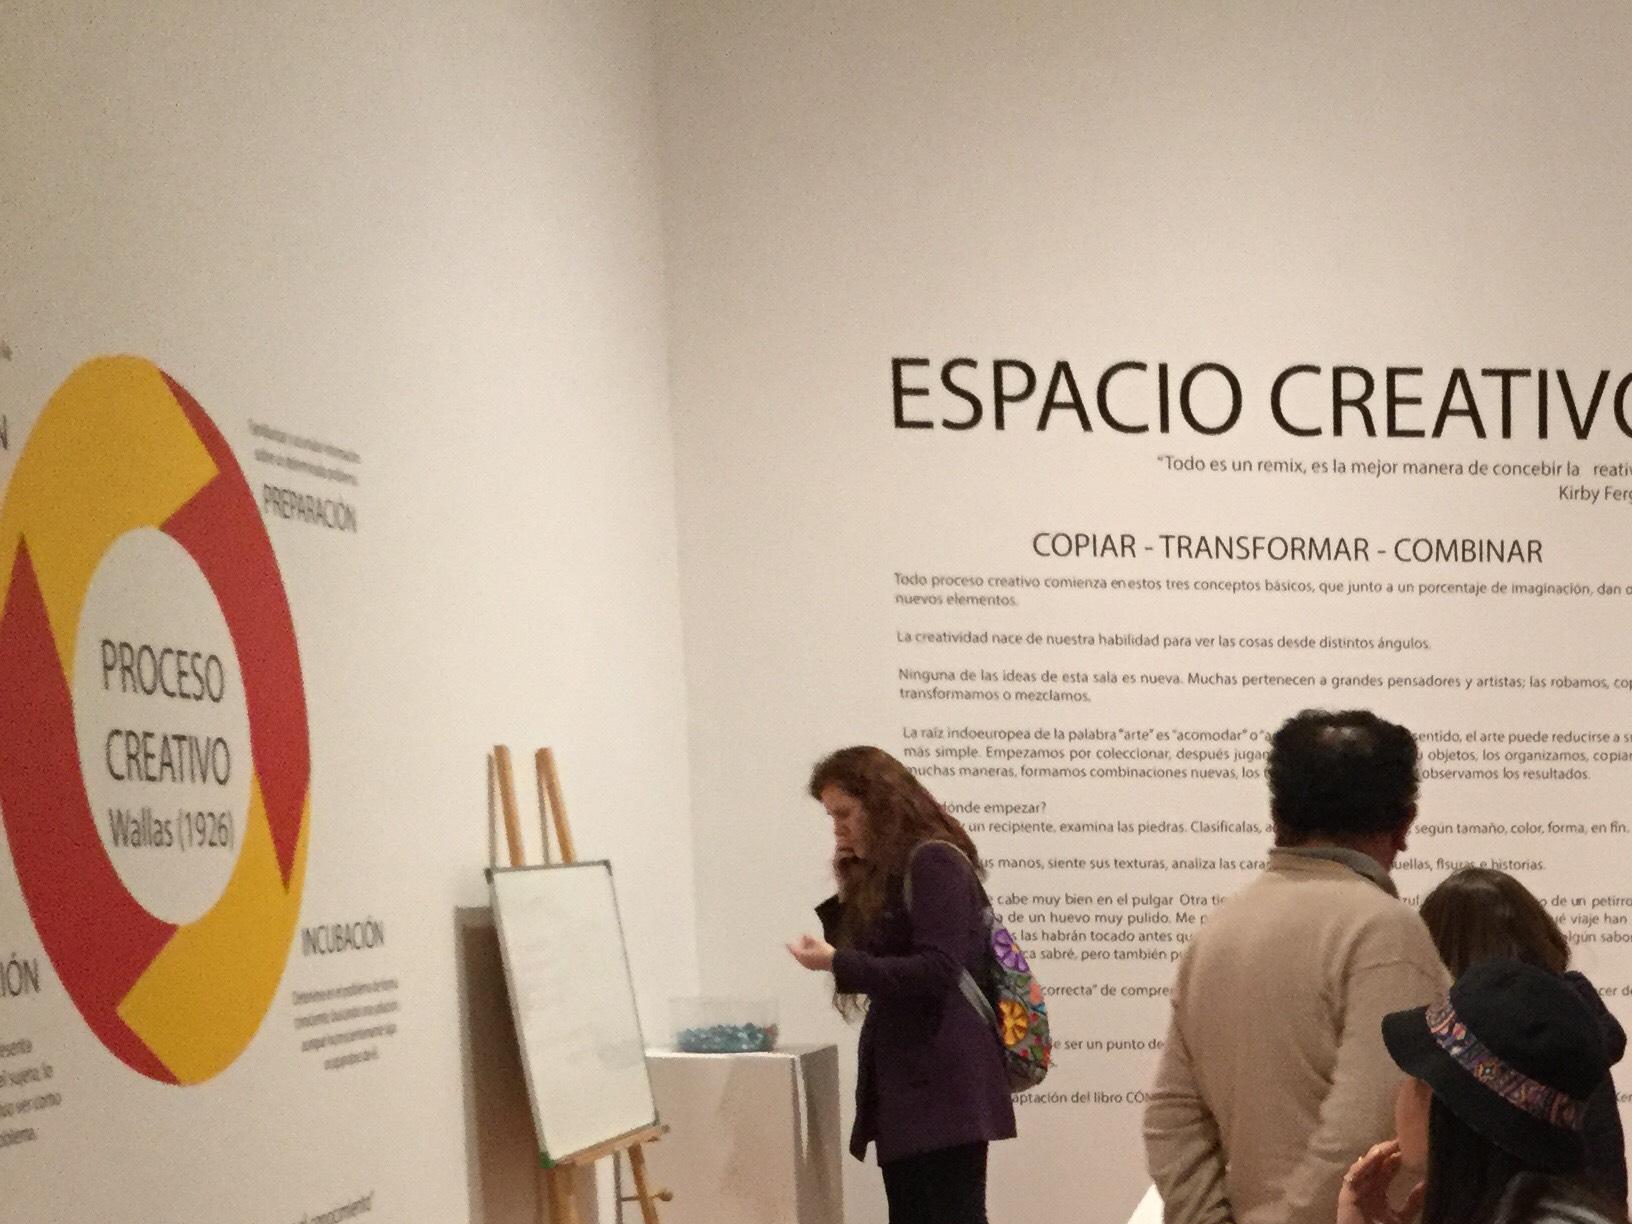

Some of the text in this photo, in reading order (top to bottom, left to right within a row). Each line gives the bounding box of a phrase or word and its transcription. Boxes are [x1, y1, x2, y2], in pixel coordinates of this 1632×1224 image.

[890, 356, 1243, 436] ESPACIO
[1209, 459, 1227, 472] es
[1231, 460, 1253, 472] un
[1257, 460, 1306, 474] remix,
[1311, 461, 1328, 473] es
[1332, 458, 1346, 473] la
[1350, 458, 1398, 478] mejor
[1402, 462, 1464, 475] manera
[1468, 459, 1488, 476] de
[1492, 460, 1562, 476] concebir
[1566, 460, 1580, 476] la
[1558, 484, 1600, 504] Kirby
[1032, 531, 1543, 564] COPIAR TRANSFORMAR COMBINAR
[894, 572, 928, 585] Todo
[930, 575, 984, 588] proceso
[987, 575, 1040, 587] creativo
[1043, 577, 1108, 589] comienza
[1165, 579, 1190, 590] tres
[1193, 579, 1261, 594] conceptos
[1318, 582, 1344, 595] que
[1346, 581, 1382, 595] junto
[1418, 582, 1487, 597] porcentaje
[1596, 582, 1622, 595] dan
[894, 594, 943, 605] nuevos
[914, 630, 989, 644] creatividad
[991, 634, 1023, 644] nace
[1046, 633, 1095, 645] nuestra
[1098, 633, 1160, 646] habilidad
[1162, 636, 1192, 649] para
[1194, 637, 1214, 647] ver
[1218, 634, 1236, 648] las
[1238, 637, 1274, 648] cosas
[1276, 635, 1316, 648] desde
[1319, 635, 1374, 649] distintos
[100, 637, 226, 704] PROCESO
[898, 668, 956, 683] Ninguna
[980, 668, 998, 681] las
[1002, 669, 1036, 682] ideas
[1061, 671, 1088, 683] esta
[1092, 670, 1118, 684] sala
[1187, 672, 1238, 685] Muchas
[1241, 674, 1316, 687] pertenecen
[1330, 673, 1383, 689] grandes
[1387, 674, 1461, 689] pensadores
[1476, 676, 1526, 688] artistas;
[1529, 675, 1546, 688] las
[1550, 675, 1609, 689] robamos,
[899, 686, 1000, 701] transformamos
[946, 726, 1031, 741] indoeuropea
[1068, 727, 1117, 742] palabra
[1479, 732, 1505, 742] arte
[1508, 730, 1548, 744] puede
[1551, 730, 1610, 743] reducirse
[104, 728, 231, 787] CREATIVO
[985, 745, 1064, 761] Empezamos
[1069, 749, 1090, 761] por
[1096, 747, 1171, 759] coleccionar,
[1428, 749, 1479, 763] objetos,
[1482, 748, 1500, 761] los
[1504, 751, 1588, 764] organizamos,
[958, 767, 1017, 777] maneras,
[1020, 764, 1087, 778] formamos
[1089, 765, 1187, 778] combinaciones
[1190, 768, 1238, 779] nuevas,
[1241, 766, 1259, 778] los
[1422, 768, 1499, 779] observamos
[1502, 766, 1520, 780] los
[983, 800, 1046, 815] empezar?
[108, 807, 234, 852] Wallas (1926)
[988, 821, 1056, 834] recipiente,
[1059, 822, 1114, 832] examina
[1116, 820, 1134, 833] las
[1456, 822, 1507, 834] tamaño,
[1510, 821, 1544, 834] color,
[1547, 820, 1588, 833] forma,
[997, 858, 1044, 869] manos,
[1047, 858, 1086, 869] siente
[1089, 859, 1110, 869] sus
[1113, 858, 1168, 870] texturas,
[1171, 857, 1216, 869] analiza
[1218, 857, 1236, 869] las
[997, 892, 1028, 905] cabe
[1064, 892, 1093, 904] bien
[1179, 893, 1212, 906] Otra
[1049, 911, 1090, 923] huevo
[1571, 915, 1599, 928] viaje
[1090, 930, 1135, 941] tocado
[1138, 931, 1172, 942] antes
[1080, 950, 1110, 962] pero
[1105, 1039, 1145, 1052] punto
[1093, 1091, 1123, 1103] libro
